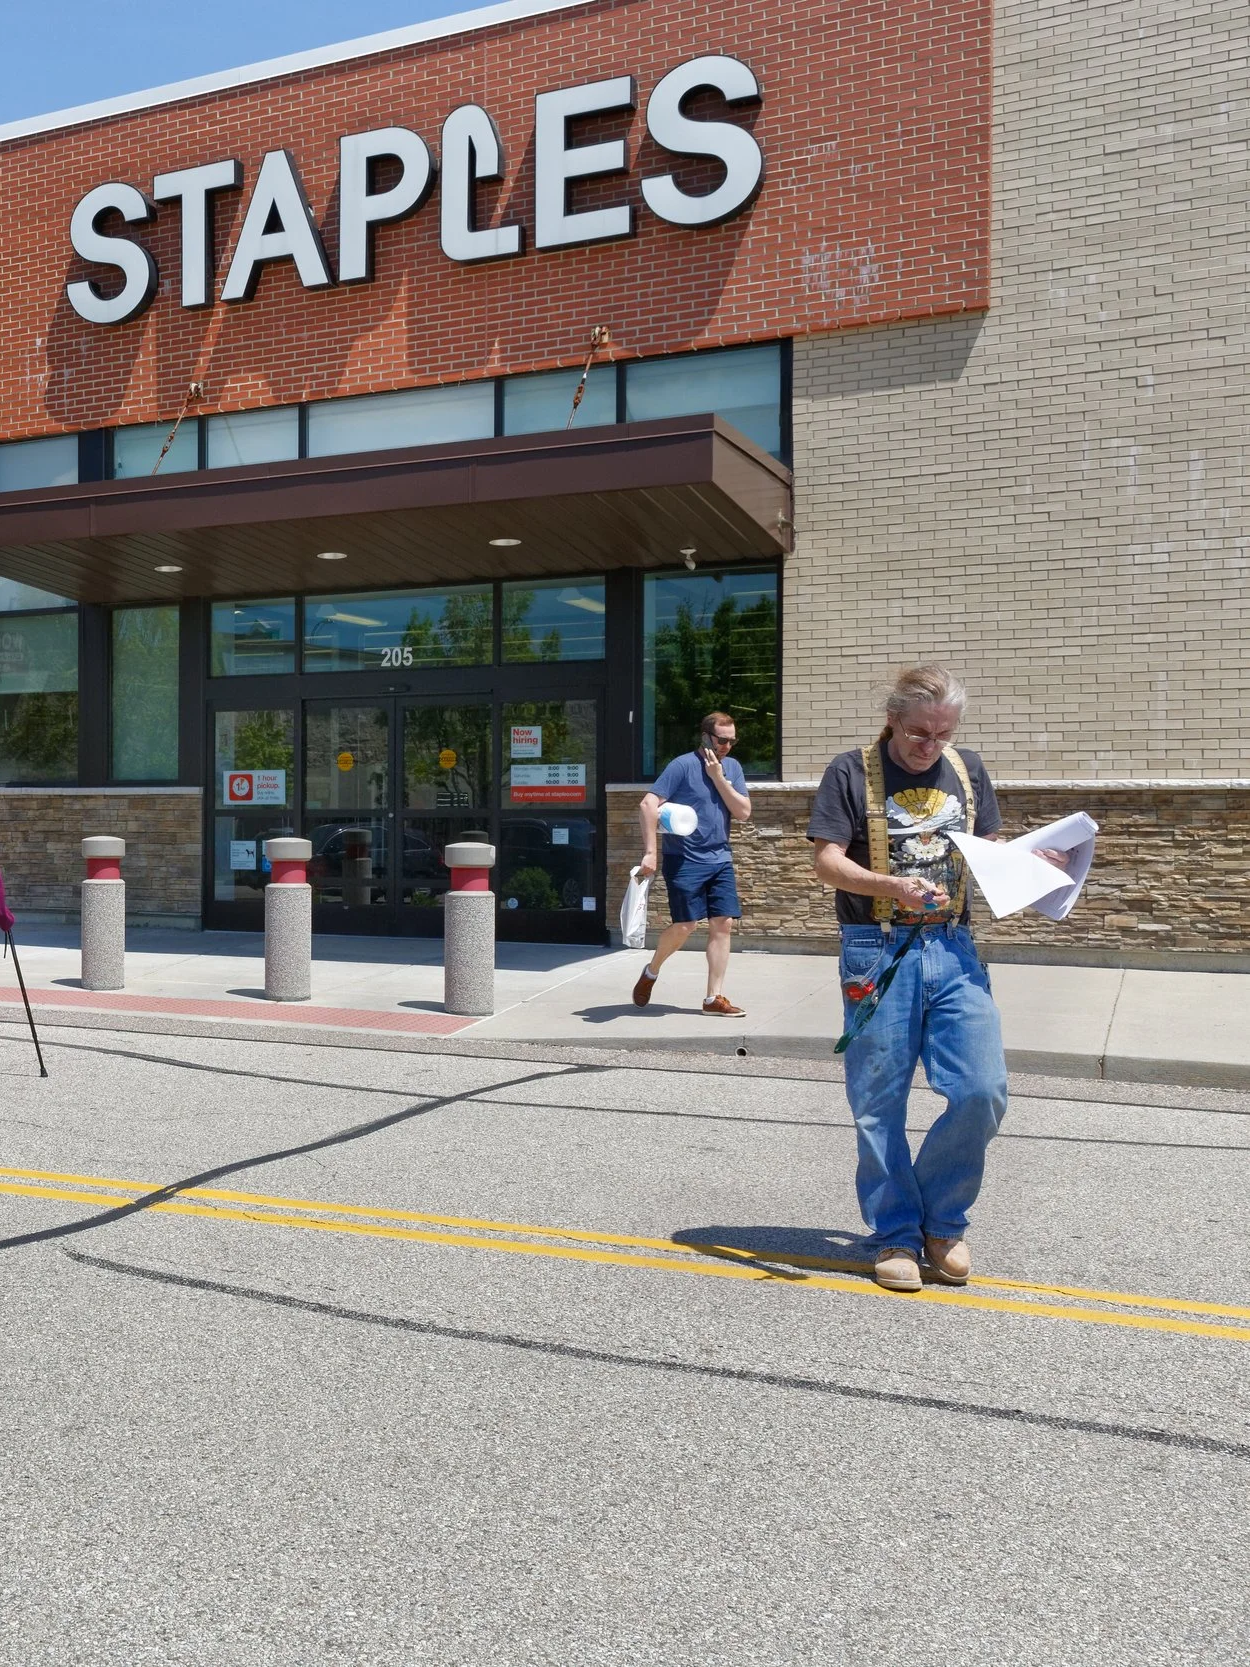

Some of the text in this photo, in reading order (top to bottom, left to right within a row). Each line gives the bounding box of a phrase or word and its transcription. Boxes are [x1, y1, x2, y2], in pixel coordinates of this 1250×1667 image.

[66, 54, 764, 325] STAPLES
[381, 647, 414, 667] 205
[513, 728, 533, 736] Now
[513, 736, 539, 745] hiring
[257, 782, 279, 790] pickup.
